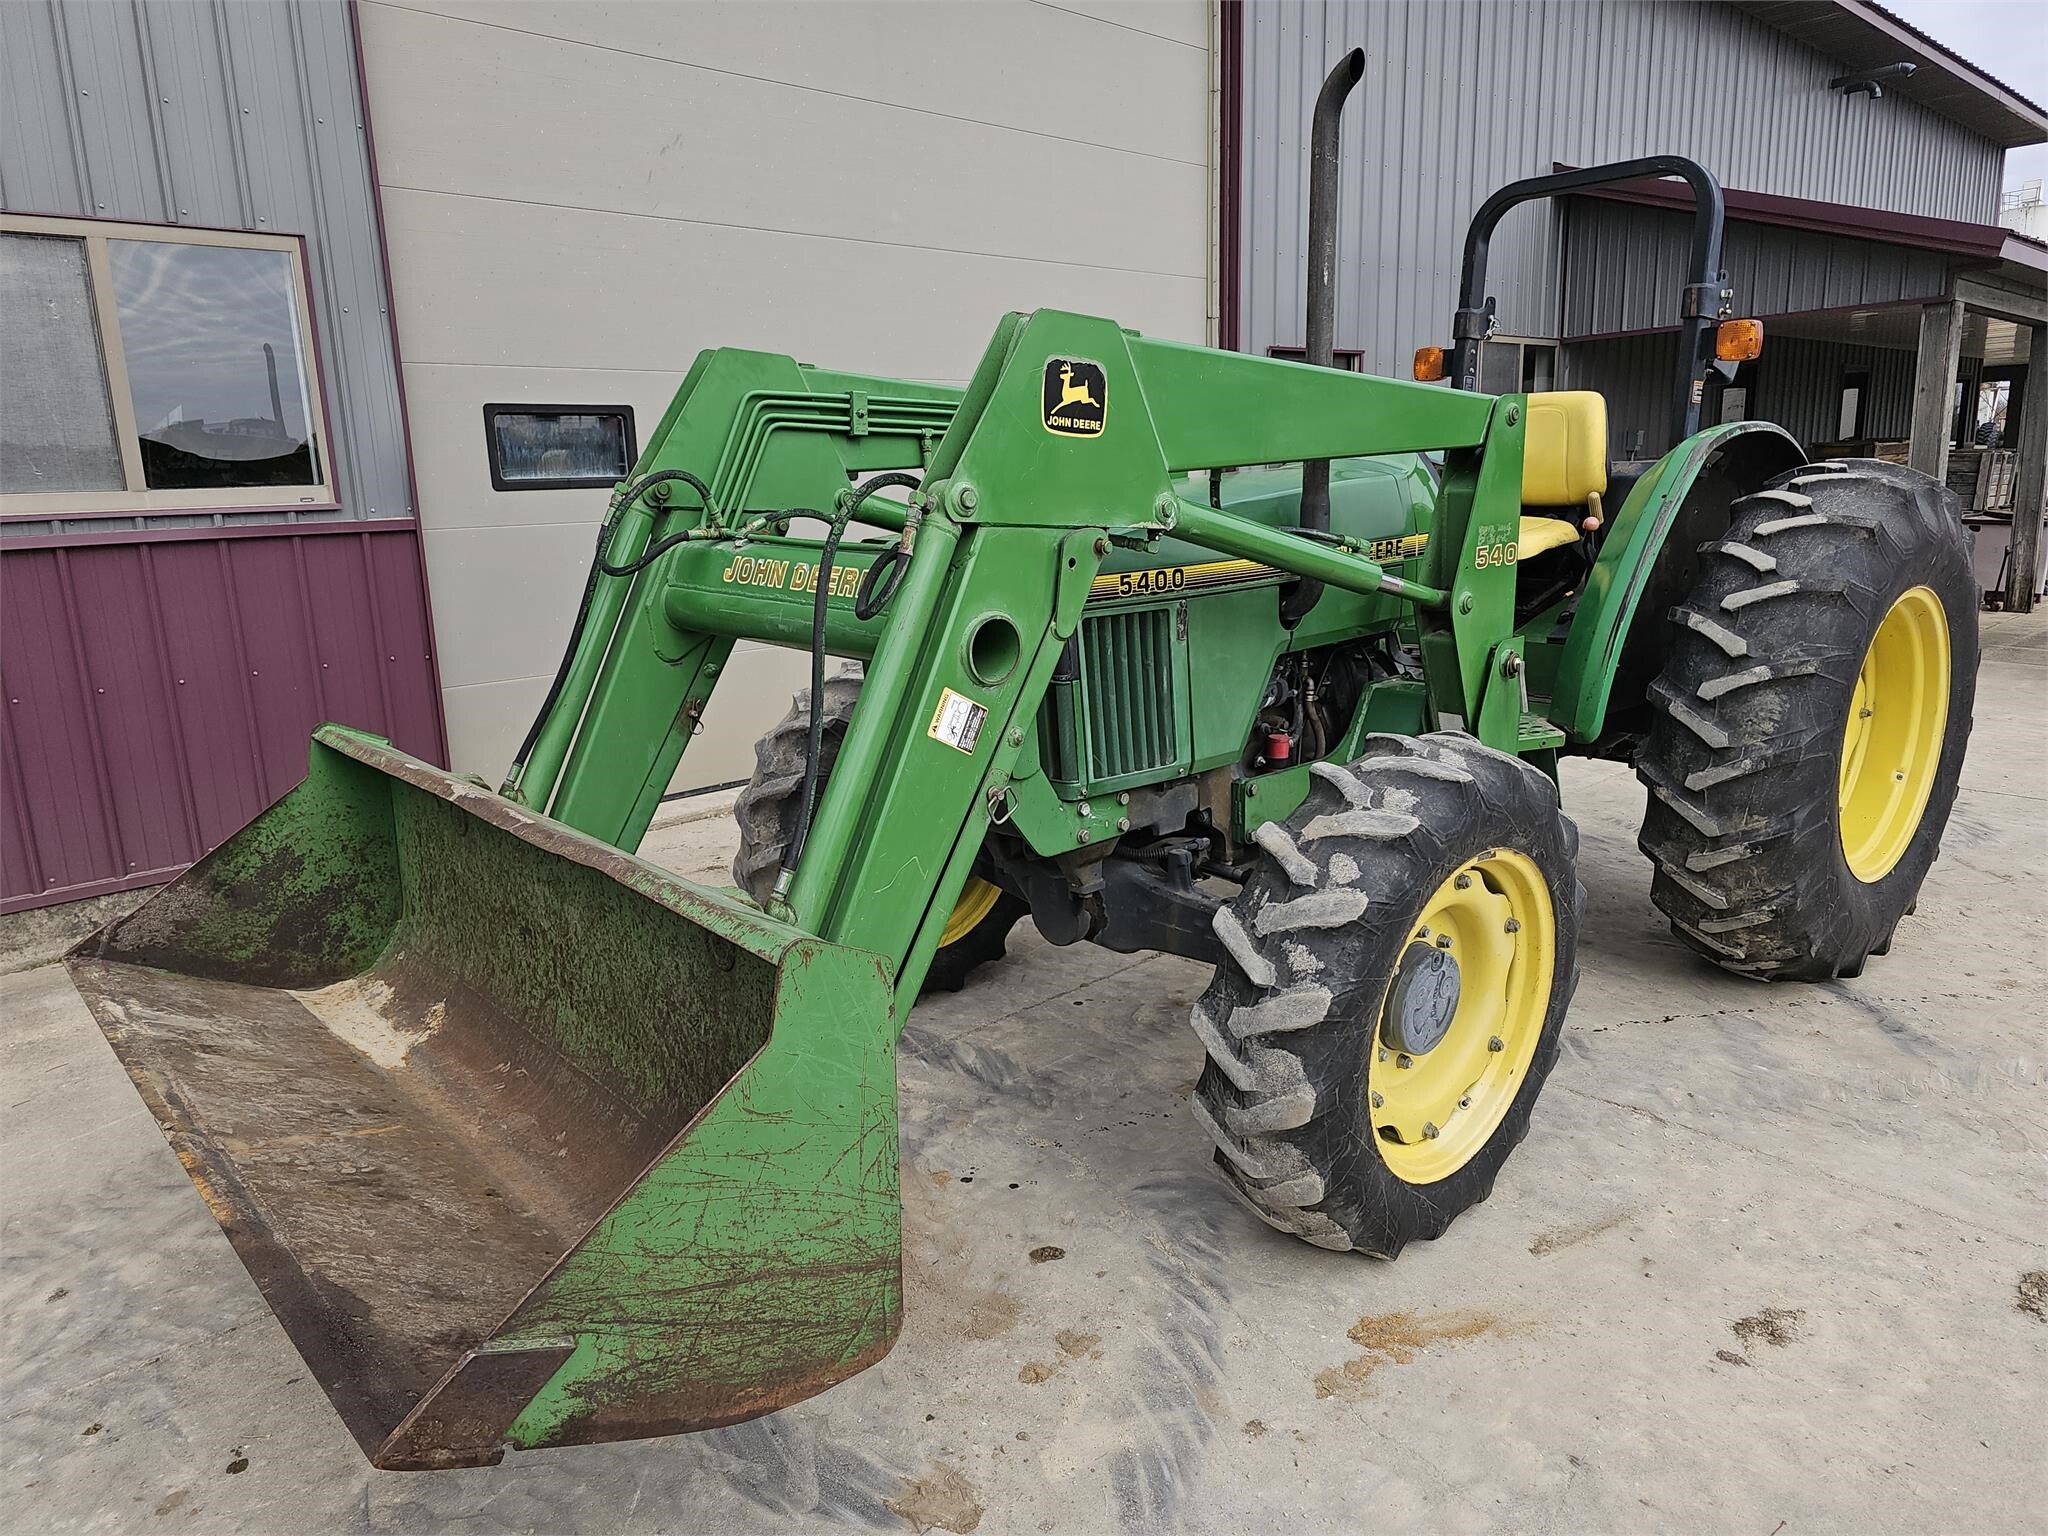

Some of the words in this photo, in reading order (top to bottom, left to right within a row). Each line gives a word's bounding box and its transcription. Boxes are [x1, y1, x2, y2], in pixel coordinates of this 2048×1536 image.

[1047, 415, 1072, 427] JOHN
[1072, 418, 1101, 430] DEERE
[1475, 541, 1518, 570] 540
[723, 556, 790, 589] JOHN
[789, 562, 869, 599] DEER
[1119, 567, 1185, 597] 5400
[935, 694, 950, 723] WARNING
